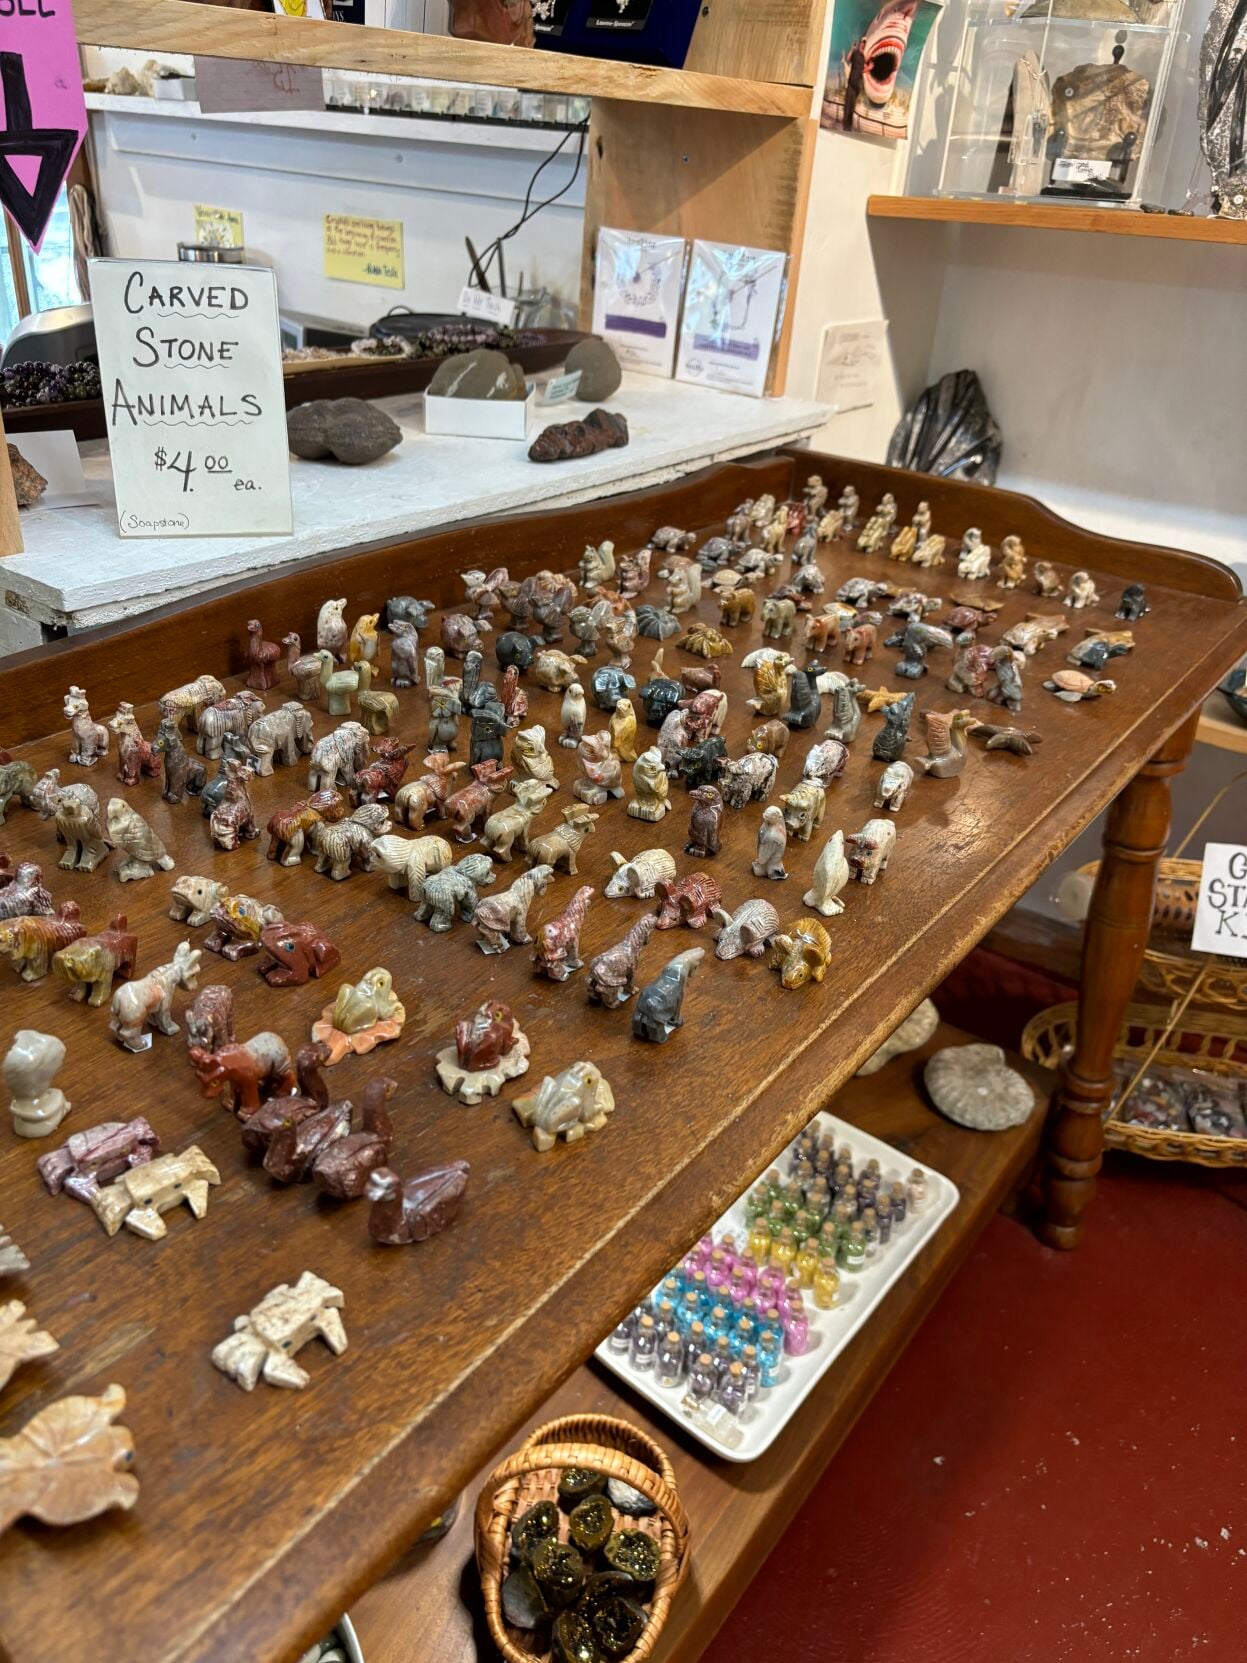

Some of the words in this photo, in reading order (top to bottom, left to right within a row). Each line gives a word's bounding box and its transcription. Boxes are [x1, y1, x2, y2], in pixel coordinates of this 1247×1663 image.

[124, 271, 249, 314] CARVED
[132, 326, 239, 368] STONE
[111, 378, 263, 426] ANIMALS
[233, 478, 263, 491] ea.
[119, 510, 190, 533] (Soapstone)
[1207, 878, 1247, 909] ST
